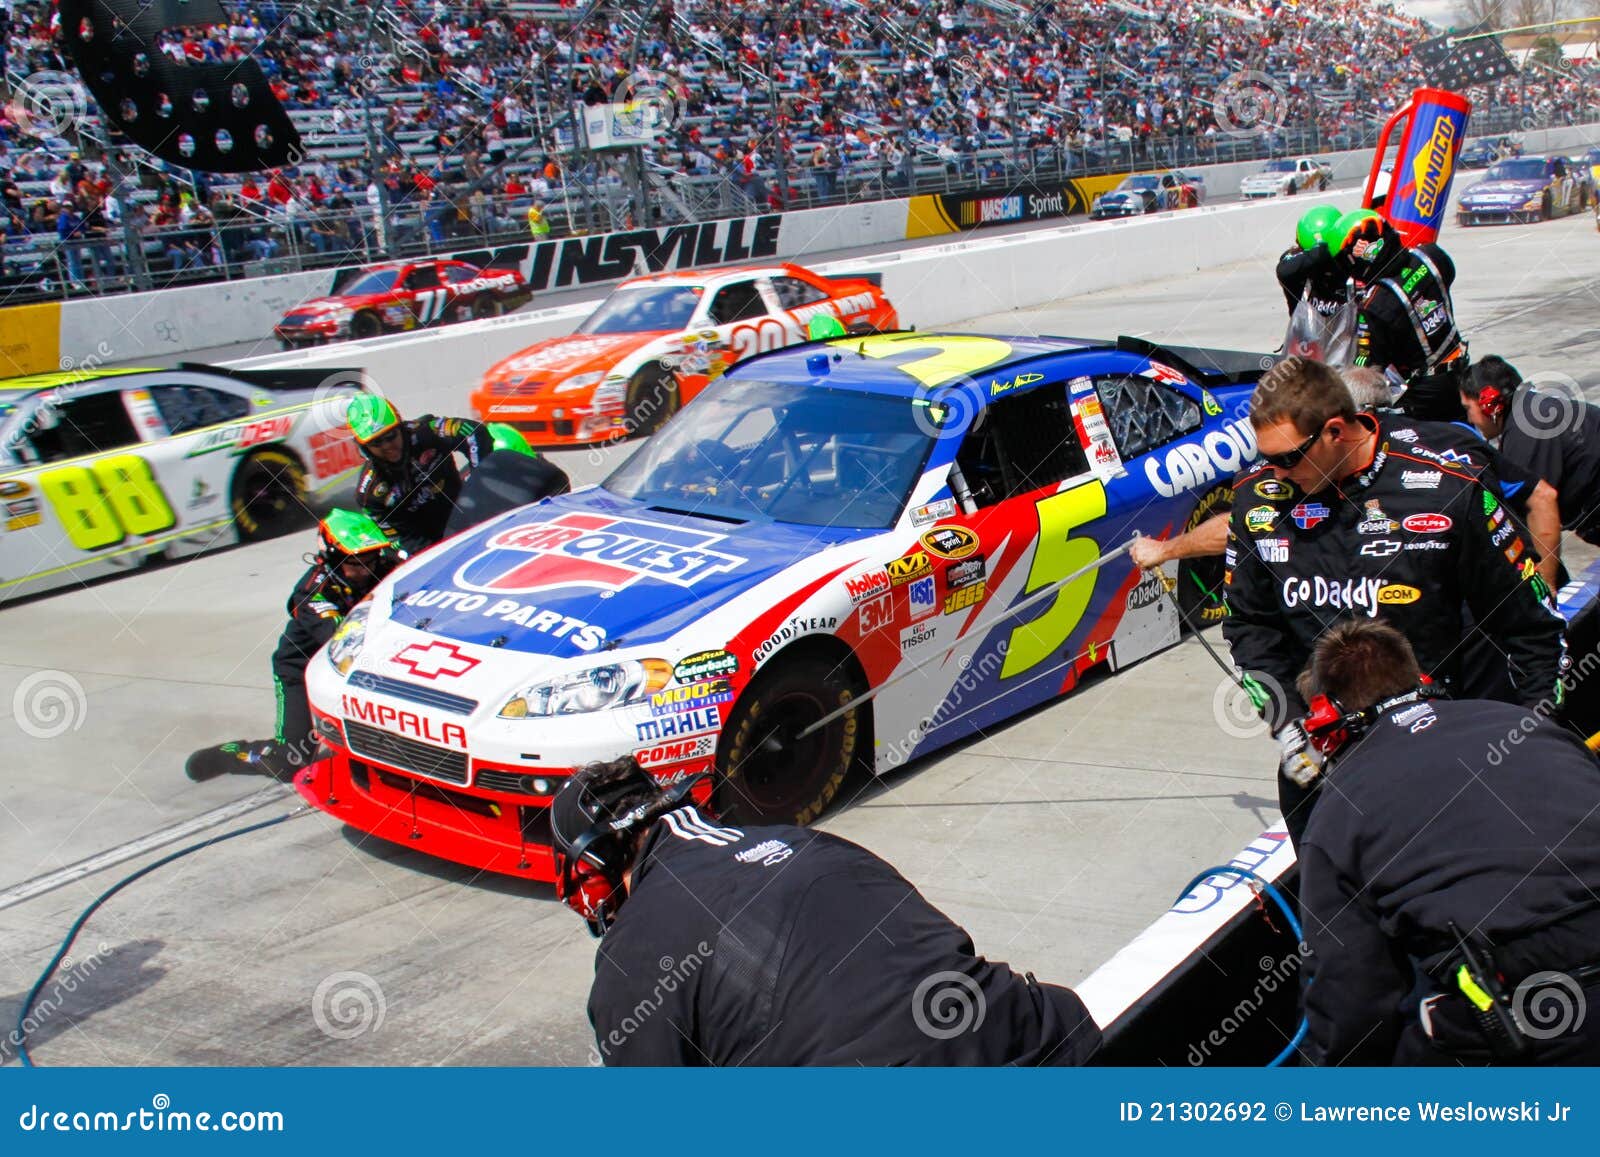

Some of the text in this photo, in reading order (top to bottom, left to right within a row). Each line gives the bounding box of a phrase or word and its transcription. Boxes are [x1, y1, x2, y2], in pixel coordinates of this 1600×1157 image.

[1416, 117, 1455, 217] SUNOCO
[980, 195, 1021, 221] NASCAR
[1028, 192, 1064, 219] Sprint
[1144, 415, 1258, 498] CARQU
[38, 453, 177, 552] 88
[1188, 486, 1235, 532] GOODYE
[844, 570, 890, 597] Holley
[909, 577, 935, 606] USG
[999, 479, 1108, 681] 5
[860, 594, 892, 633] 3M
[944, 581, 987, 616] JEGS
[402, 589, 607, 651] AUTO PARTS
[901, 628, 938, 651] TISSOT
[674, 654, 736, 678] Gatorback
[680, 650, 726, 665] GOODYEAR
[681, 667, 736, 684] BELTS
[341, 693, 468, 750] IMPALA
[635, 706, 721, 742] MAHLE
[635, 739, 698, 766] COMP
